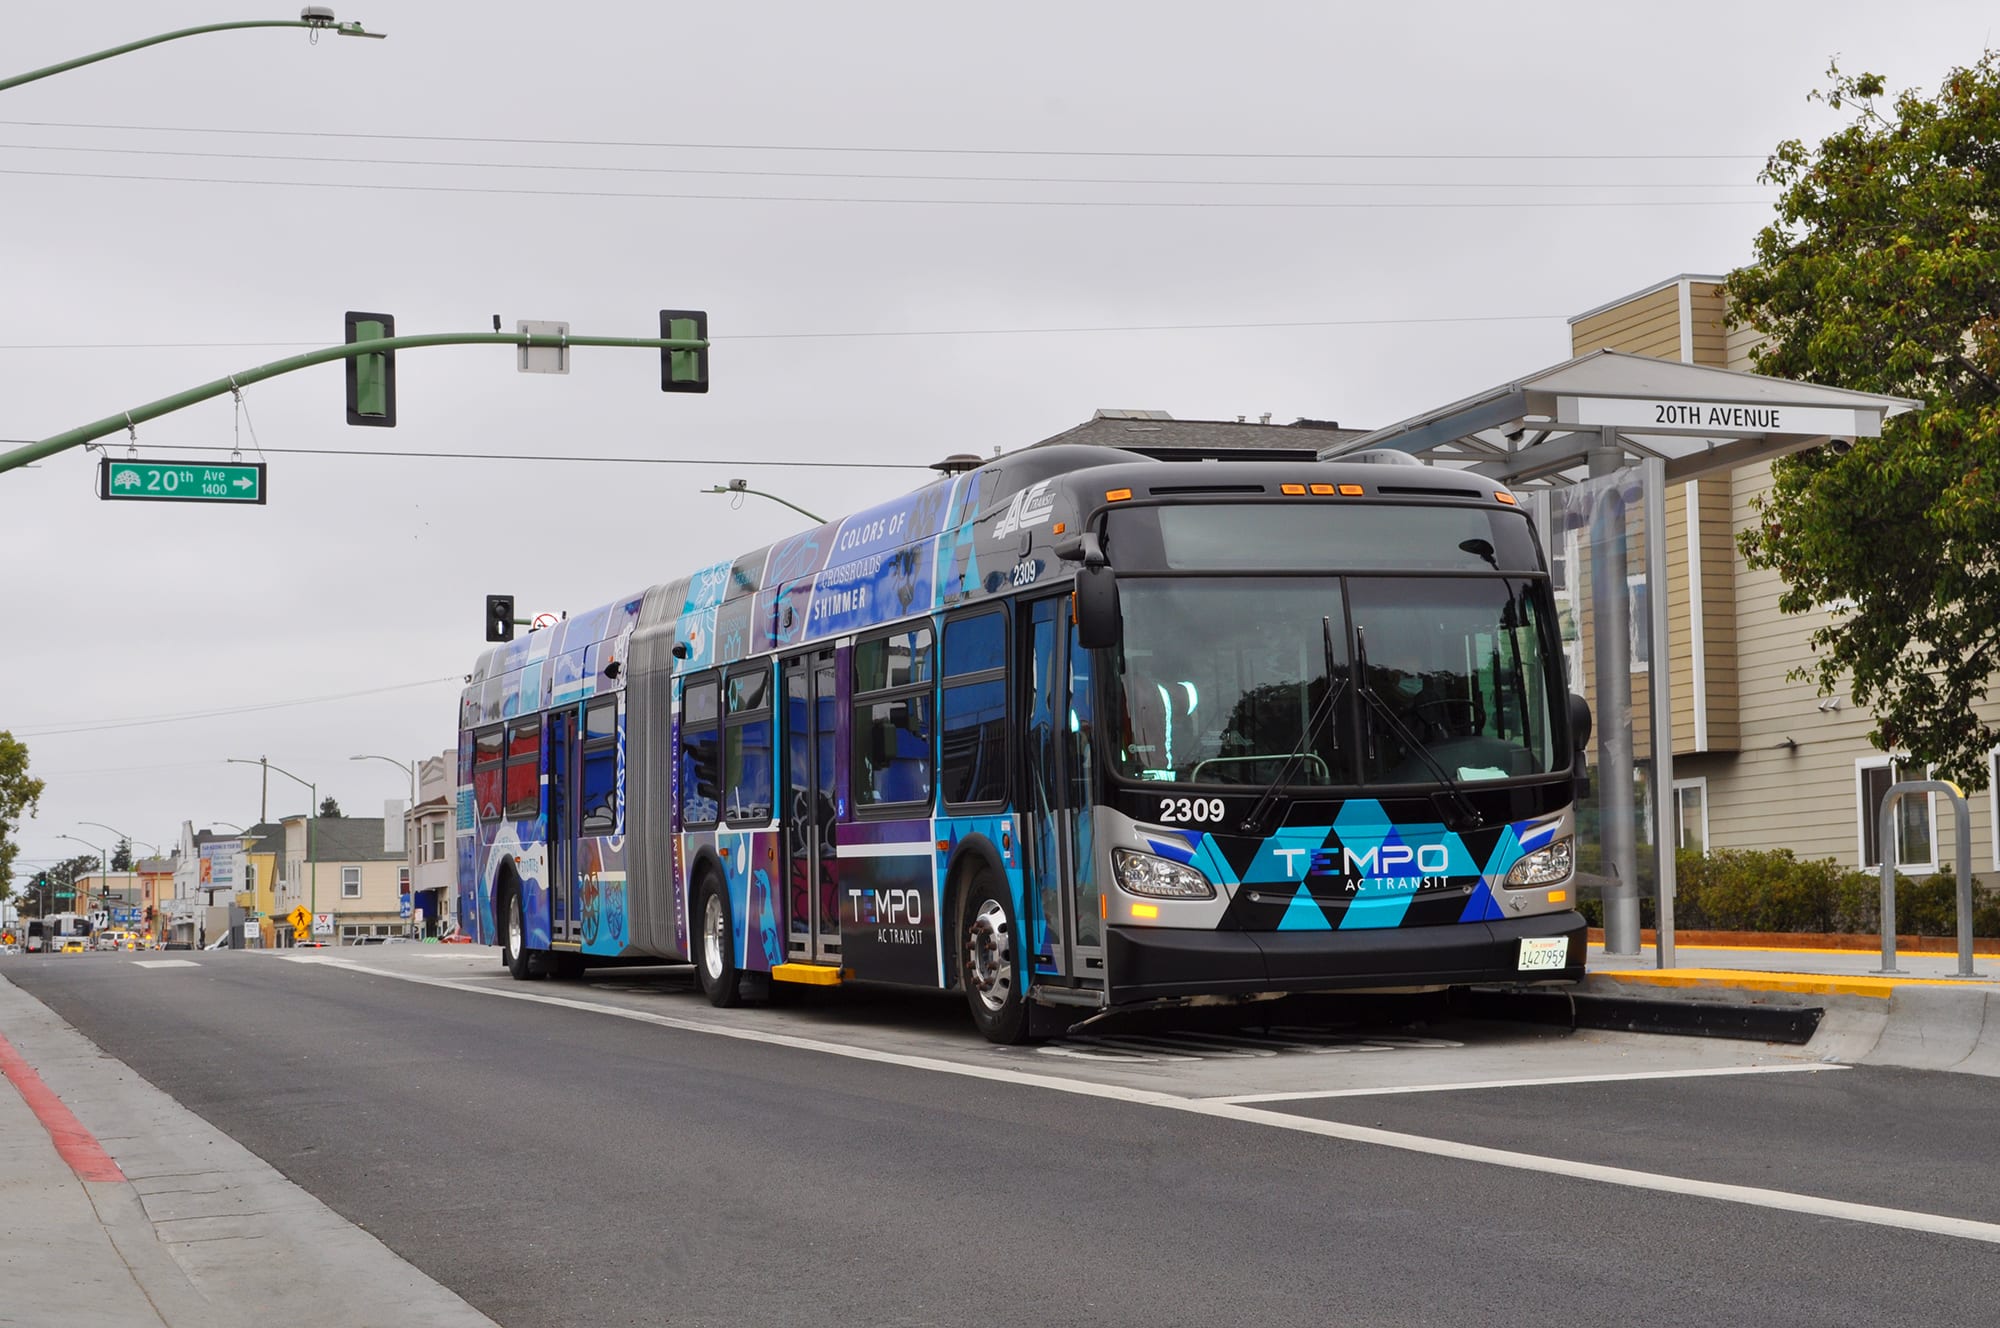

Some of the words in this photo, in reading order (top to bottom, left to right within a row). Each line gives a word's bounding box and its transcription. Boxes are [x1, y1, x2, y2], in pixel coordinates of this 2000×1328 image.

[1656, 404, 1701, 425] 20TH
[1709, 407, 1780, 428] AVENUE
[147, 469, 194, 492] 20th
[203, 469, 226, 482] Ave
[201, 483, 227, 495] 1400
[992, 480, 1053, 540] AC
[840, 517, 886, 552] COLORS
[888, 511, 906, 536] OF
[821, 555, 882, 589] CROSSROADS
[1013, 559, 1036, 587] 2309
[814, 587, 867, 621] SHIMMER
[1160, 798, 1225, 822] 2309
[1273, 844, 1449, 878] TEMPO
[1345, 878, 1366, 892] AC
[1375, 875, 1448, 890] TRANSIT
[848, 889, 922, 925] TEMPO
[877, 928, 888, 944] AC
[889, 928, 923, 945] TRANSIT
[1521, 949, 1565, 966] 1427959
